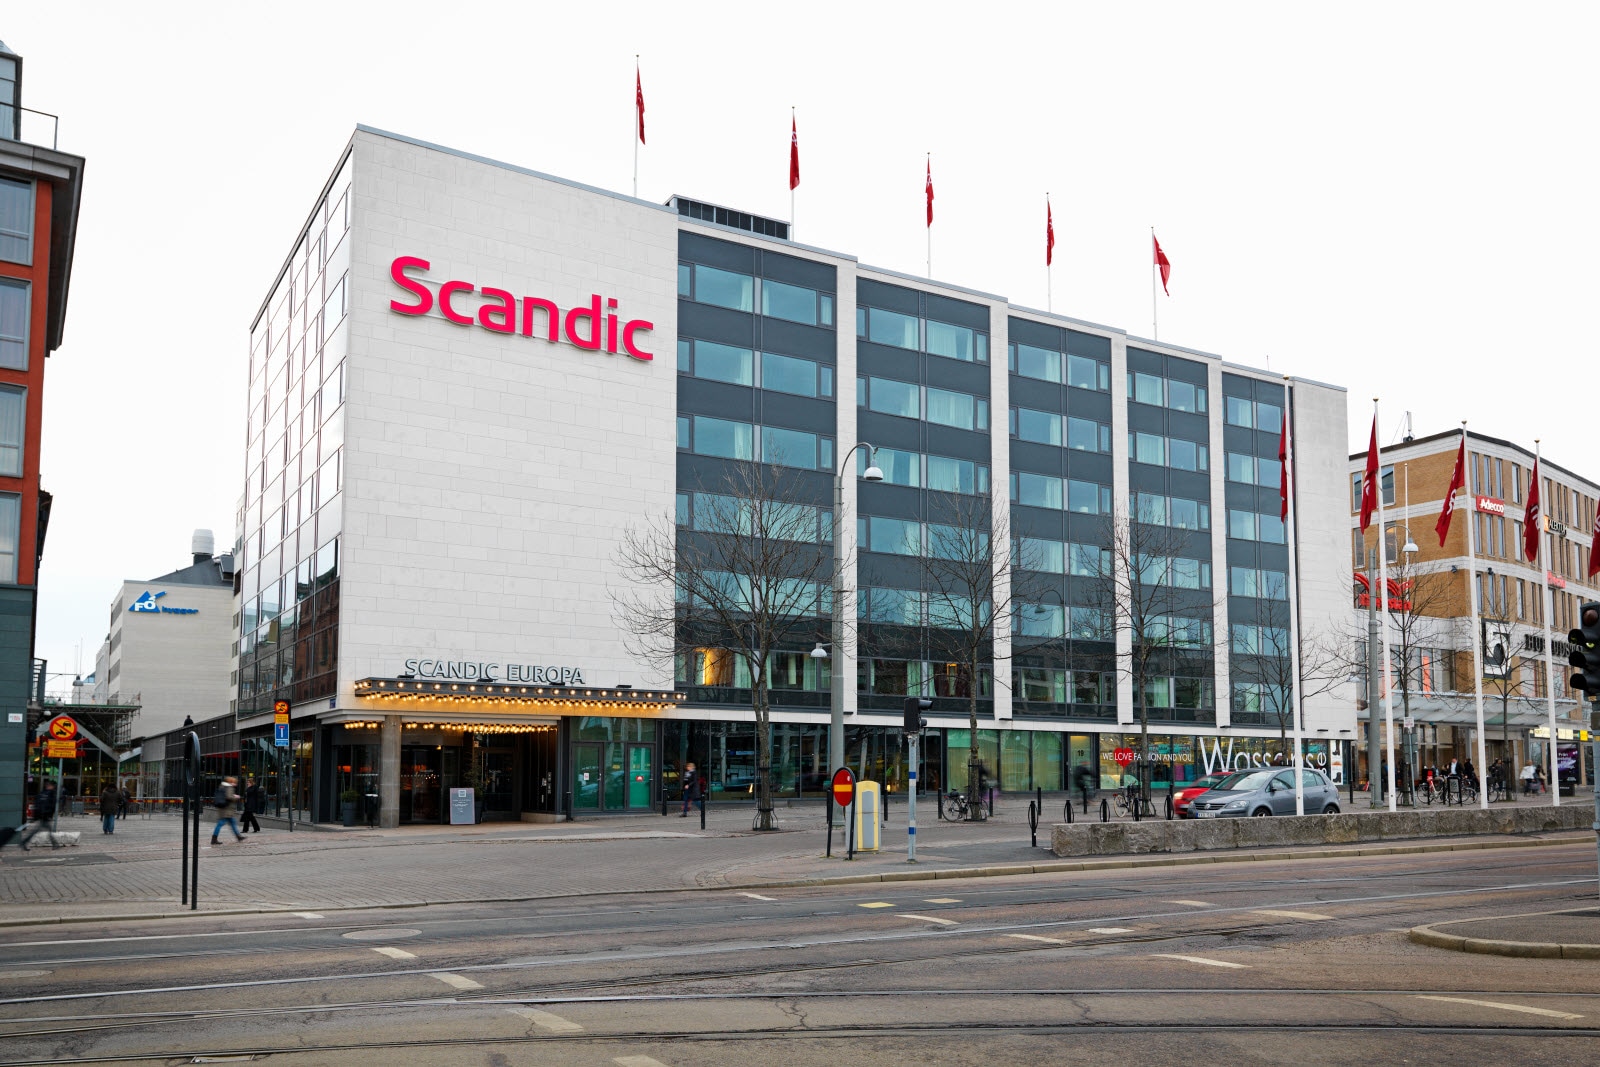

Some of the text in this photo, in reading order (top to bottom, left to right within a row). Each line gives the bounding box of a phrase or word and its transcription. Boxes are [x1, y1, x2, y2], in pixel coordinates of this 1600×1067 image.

[390, 256, 653, 361] Scandic
[1480, 498, 1504, 513] Adecco
[405, 659, 586, 684] SCANDIC EUROPA
[1103, 753, 1113, 761] WE
[1114, 753, 1133, 761] LOVE
[1163, 754, 1177, 762] AND
[1179, 754, 1192, 762] YOU
